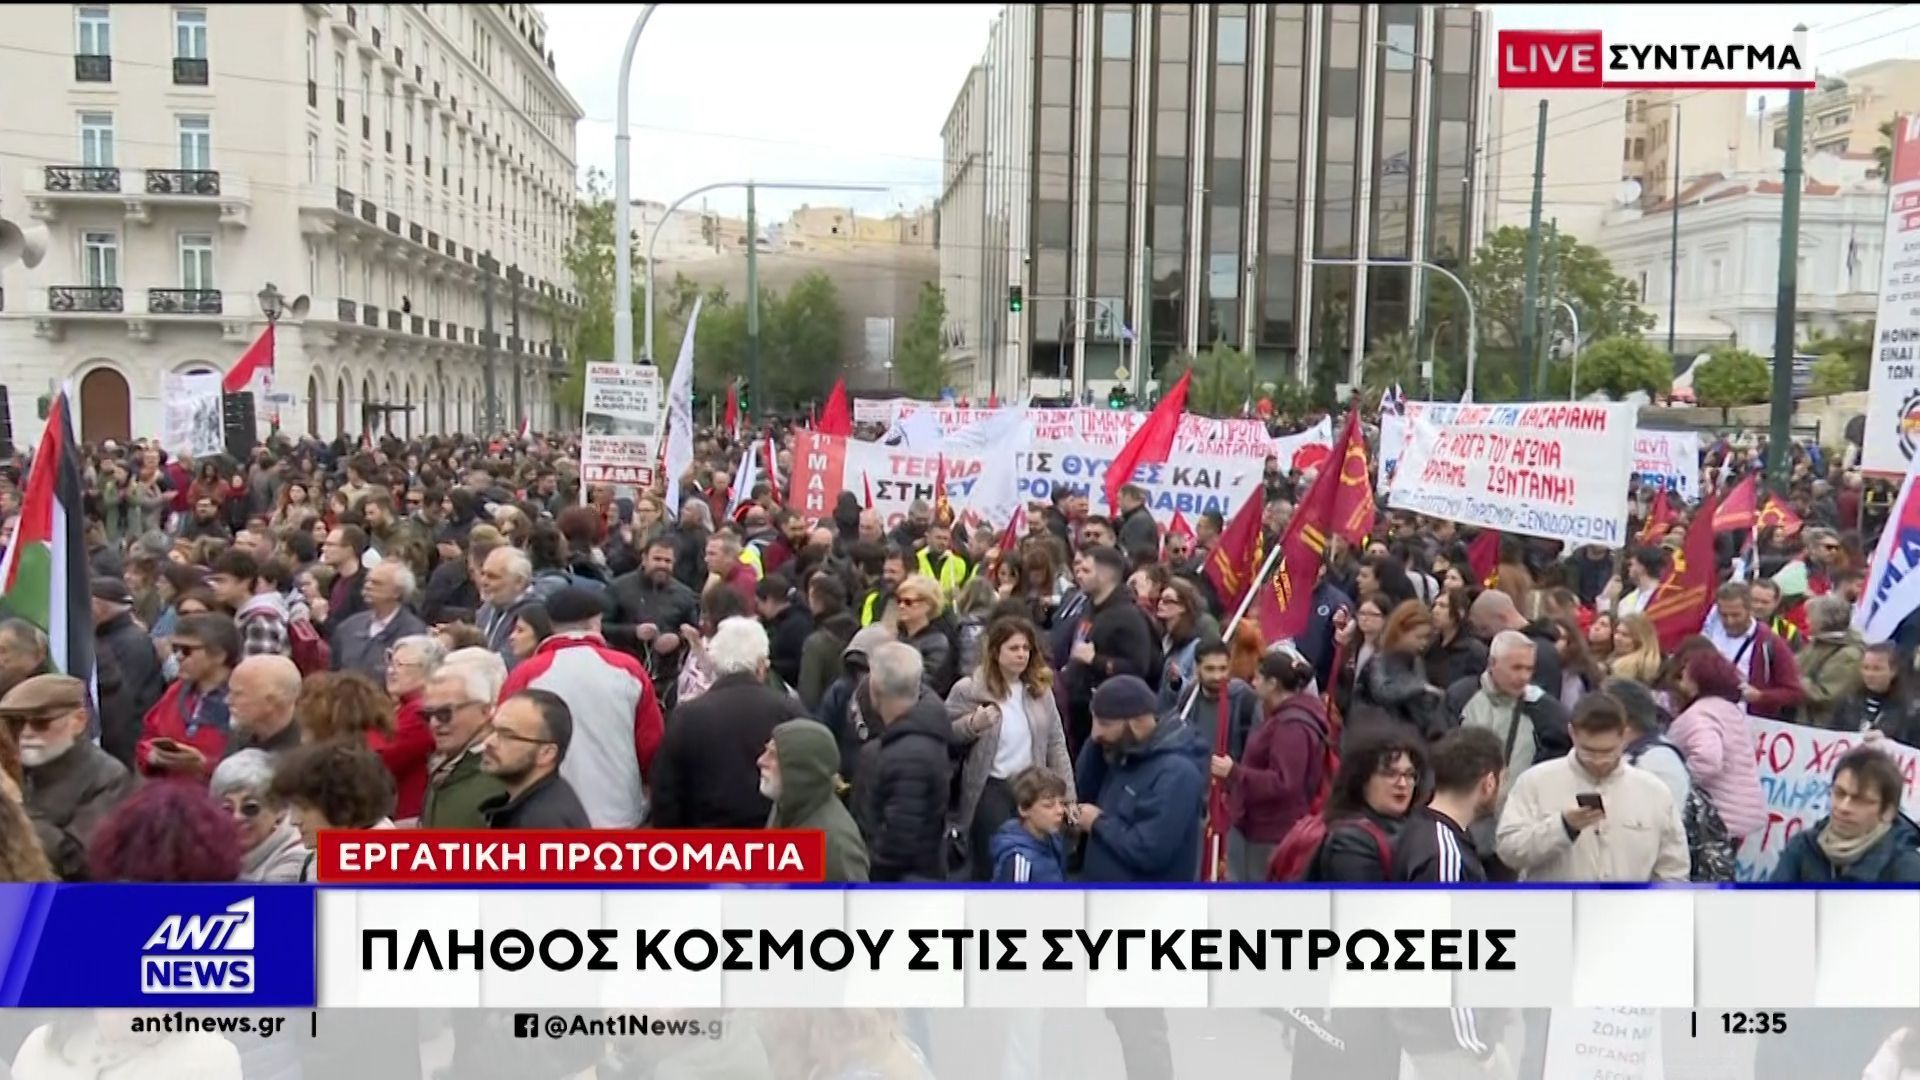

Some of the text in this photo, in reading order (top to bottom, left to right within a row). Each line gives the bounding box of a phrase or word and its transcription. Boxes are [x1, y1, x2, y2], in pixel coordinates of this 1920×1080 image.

[1488, 434, 1512, 462] ΤΟΥ
[1512, 438, 1562, 467] ΑΓΩΝΑ
[586, 466, 651, 484] ΠΑΜΕ
[1016, 451, 1053, 472] ΤΙΣ
[1172, 466, 1222, 489] ΚΑΙ
[1487, 464, 1576, 505] ΖΩΝΤΑΝΗ!
[876, 479, 933, 501] ΣΤΗ
